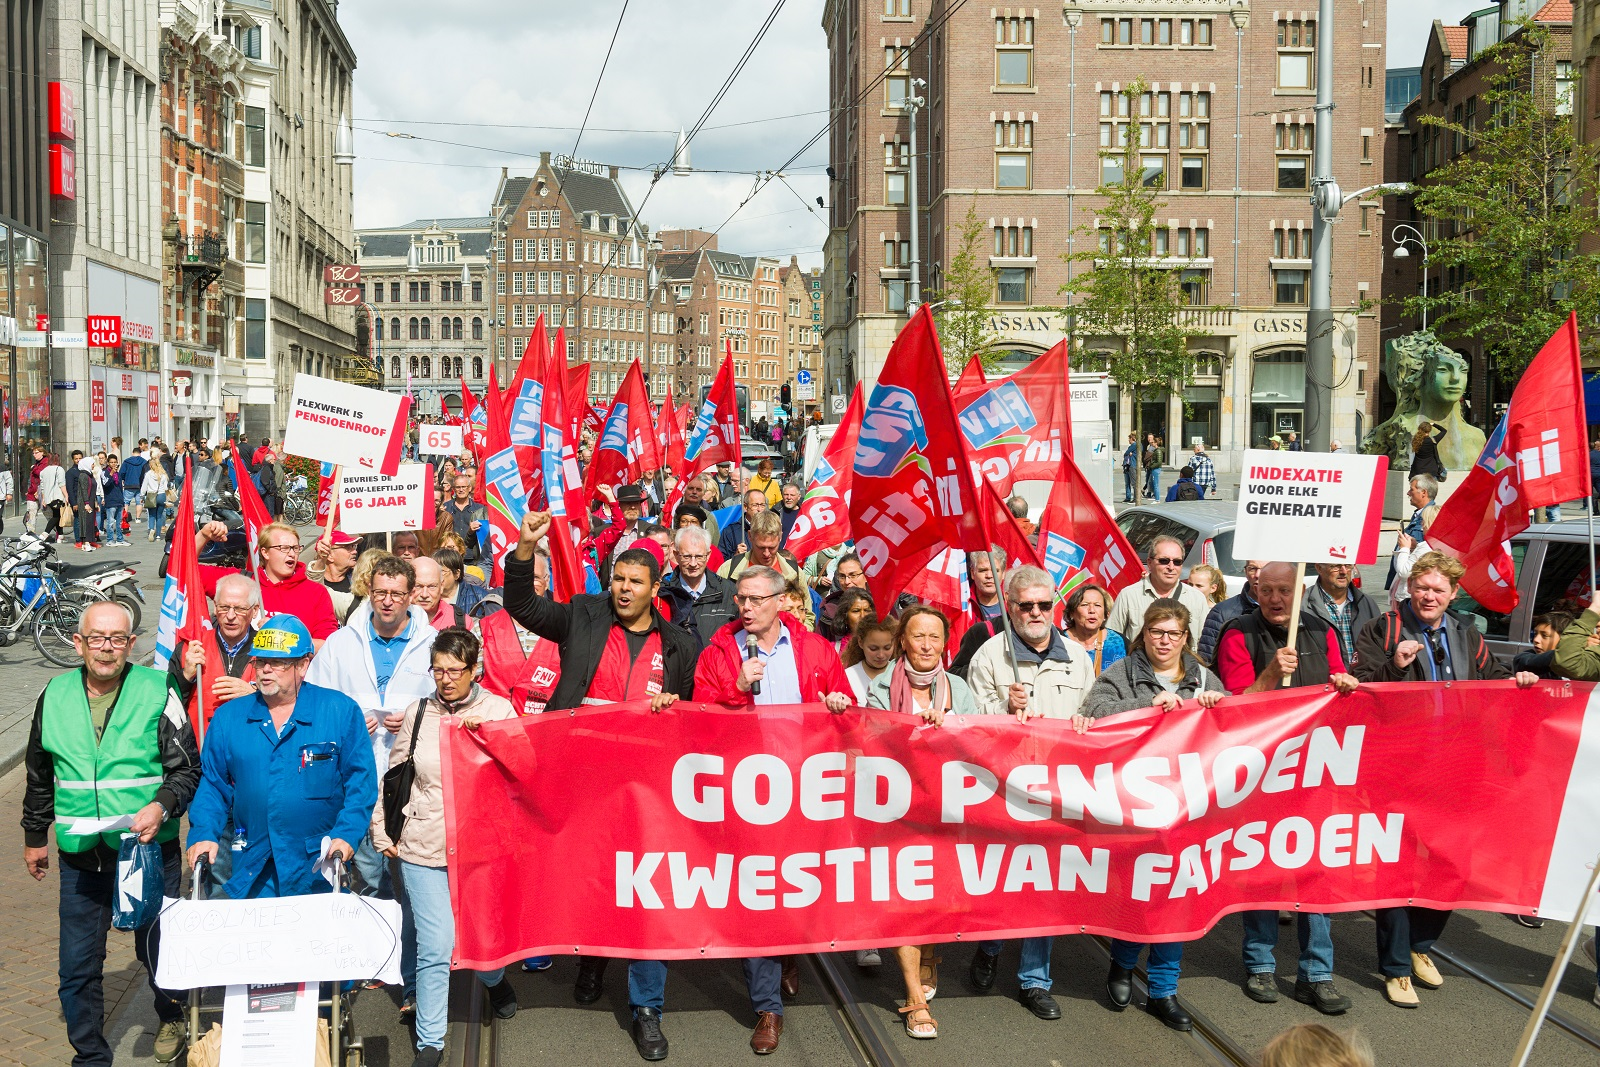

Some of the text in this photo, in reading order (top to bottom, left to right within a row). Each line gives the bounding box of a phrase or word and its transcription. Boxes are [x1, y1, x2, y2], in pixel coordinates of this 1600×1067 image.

[62, 152, 73, 173] UNI
[62, 173, 74, 193] QLO
[812, 281, 821, 332] ROLEX
[91, 319, 115, 331] UNI
[126, 321, 154, 340] SEPTEMBER
[1253, 318, 1308, 333] GASS
[91, 331, 118, 345] QLO
[149, 389, 158, 403] UNI
[149, 405, 158, 420] QLO
[297, 398, 363, 419] FLEXWERK IS
[295, 410, 387, 437] PENSIOENROOF
[427, 431, 451, 449] 65
[343, 476, 379, 484] BEVRIES
[1250, 466, 1343, 484] INDEXATIE
[344, 484, 404, 494] AOW-LEEFTIJD
[1248, 484, 1319, 497] VOOR ELKE
[345, 496, 407, 509] 66 JAAR
[1246, 501, 1343, 519] GENERATIE
[256, 636, 287, 650] SJAAK
[533, 668, 555, 684] FNV
[527, 689, 548, 699] VOOR
[671, 725, 1366, 829] GOED PENSIOEN
[615, 812, 1404, 911] KWESTIE VAN FATSOEN
[168, 941, 273, 976] AASGIER
[309, 936, 353, 956] BETER
